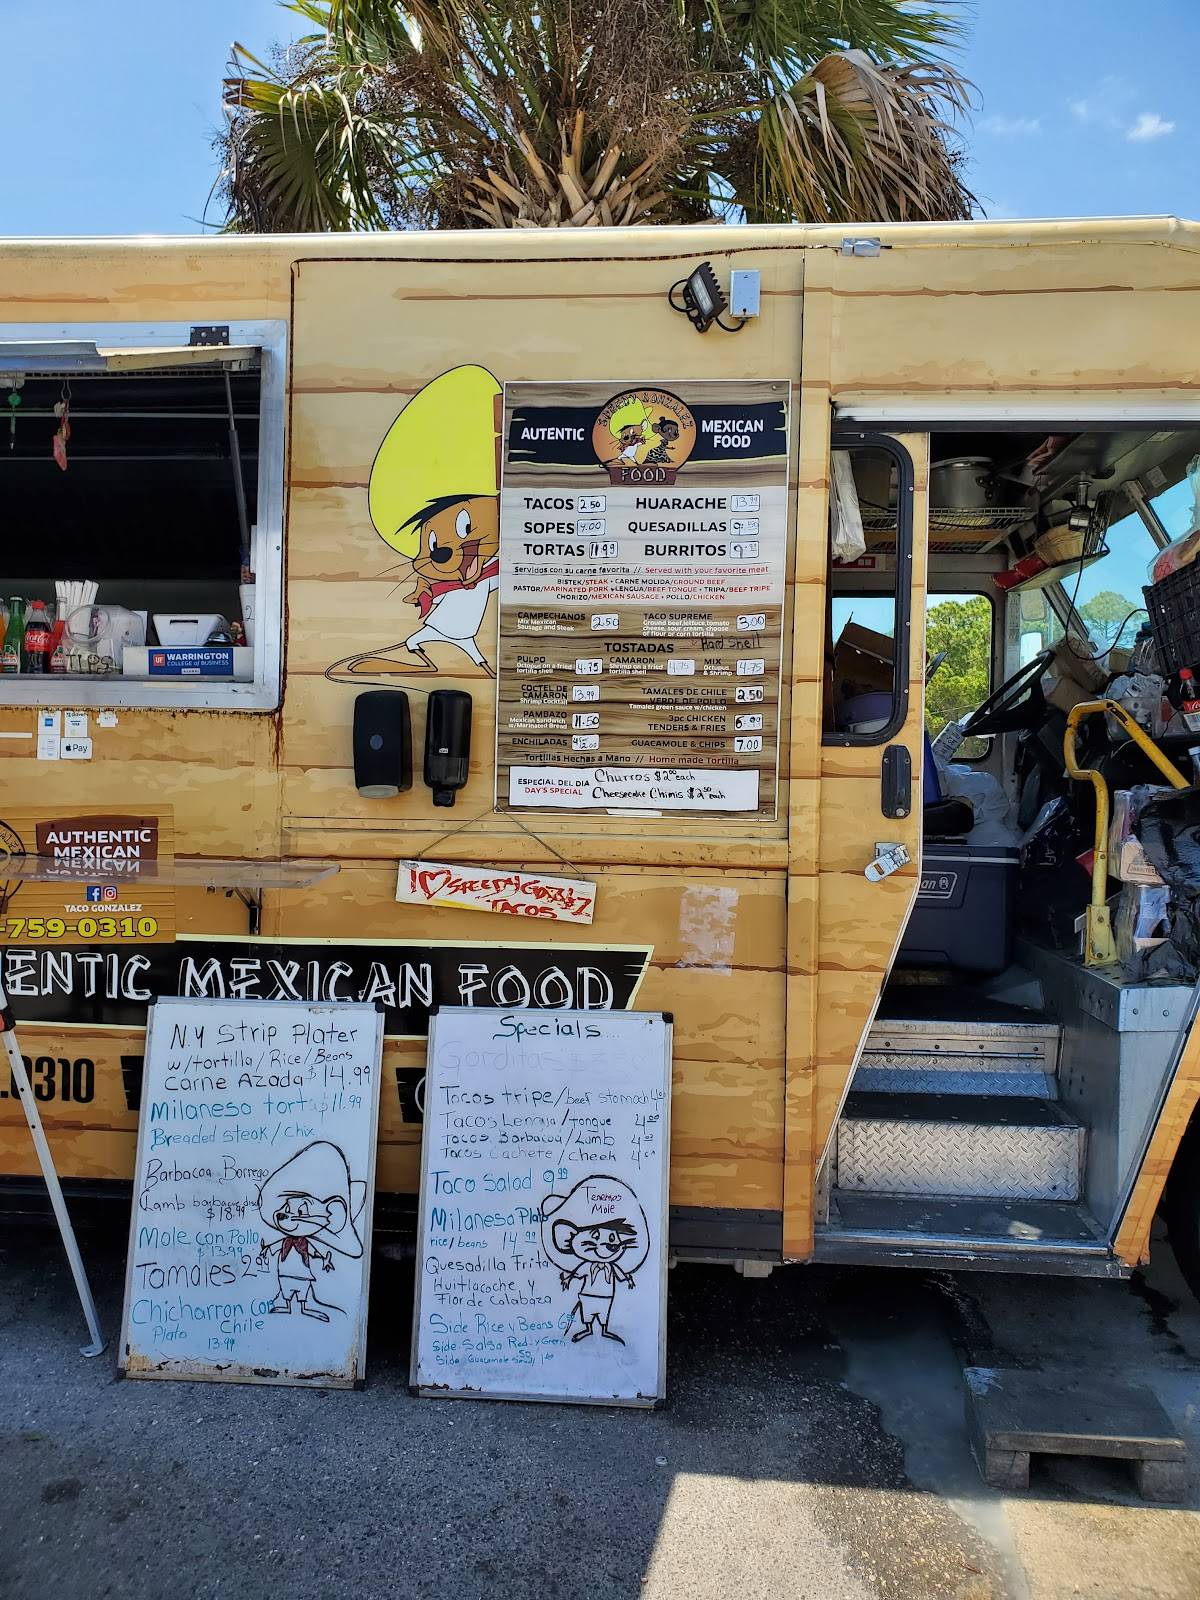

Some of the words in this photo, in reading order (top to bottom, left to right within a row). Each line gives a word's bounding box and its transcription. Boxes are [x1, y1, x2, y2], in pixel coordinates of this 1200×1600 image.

[701, 420, 764, 432] MEXICAN
[521, 427, 584, 441] AUTENTIC
[713, 435, 751, 448] FOOD
[622, 468, 666, 481] FOOD
[524, 498, 574, 510] TACOS
[636, 498, 726, 509] HUARACHE
[524, 522, 574, 534] SOPES
[628, 522, 726, 533] QUESADILLAS
[524, 544, 585, 556] TORTAS
[645, 545, 726, 556] BURRITOS
[518, 612, 585, 620] CAMPECHANOS
[604, 643, 674, 653] TOSTADAS
[167, 652, 228, 660] WARRINGTON
[66, 654, 113, 674] TIPS
[73, 744, 88, 753] Pay
[736, 740, 758, 751] 7.00
[707, 757, 739, 765] Tortilla
[594, 769, 650, 782] Churros
[676, 771, 695, 781] each
[46, 830, 151, 844] AUTHENTIC
[54, 845, 140, 858] MEXICAN
[92, 904, 142, 912] GONZALEZ
[486, 899, 557, 919] TACOS
[177, 956, 432, 1008] MEXICAN
[458, 964, 613, 1009] FOOD
[217, 1020, 277, 1045] Strip
[492, 1015, 601, 1043] Specials
[440, 1086, 494, 1105] Tacos
[440, 1111, 497, 1128] Tacos
[150, 1124, 216, 1150] Breaded
[441, 1134, 489, 1145] Tacos
[440, 1147, 481, 1158] Tacos
[145, 1158, 212, 1188] Barbacoa
[430, 1170, 476, 1195] Taco
[483, 1168, 532, 1192] Salad
[581, 1186, 622, 1202] Tenemos
[592, 1204, 615, 1215] Mole
[430, 1207, 515, 1232] Milanesa
[139, 1227, 191, 1249] Mole
[228, 1230, 259, 1245] Pollo
[426, 1254, 506, 1274] Quesadilla
[511, 1251, 550, 1271] Frita
[136, 1262, 236, 1289] Tamales
[132, 1296, 244, 1324] Chicharron
[430, 1312, 468, 1334] Side
[475, 1314, 504, 1334] Rice
[516, 1316, 553, 1331] Beans
[152, 1324, 187, 1344] Plato
[220, 1318, 264, 1334] Chile
[432, 1341, 456, 1351] Side
[462, 1336, 502, 1351] Salsa
